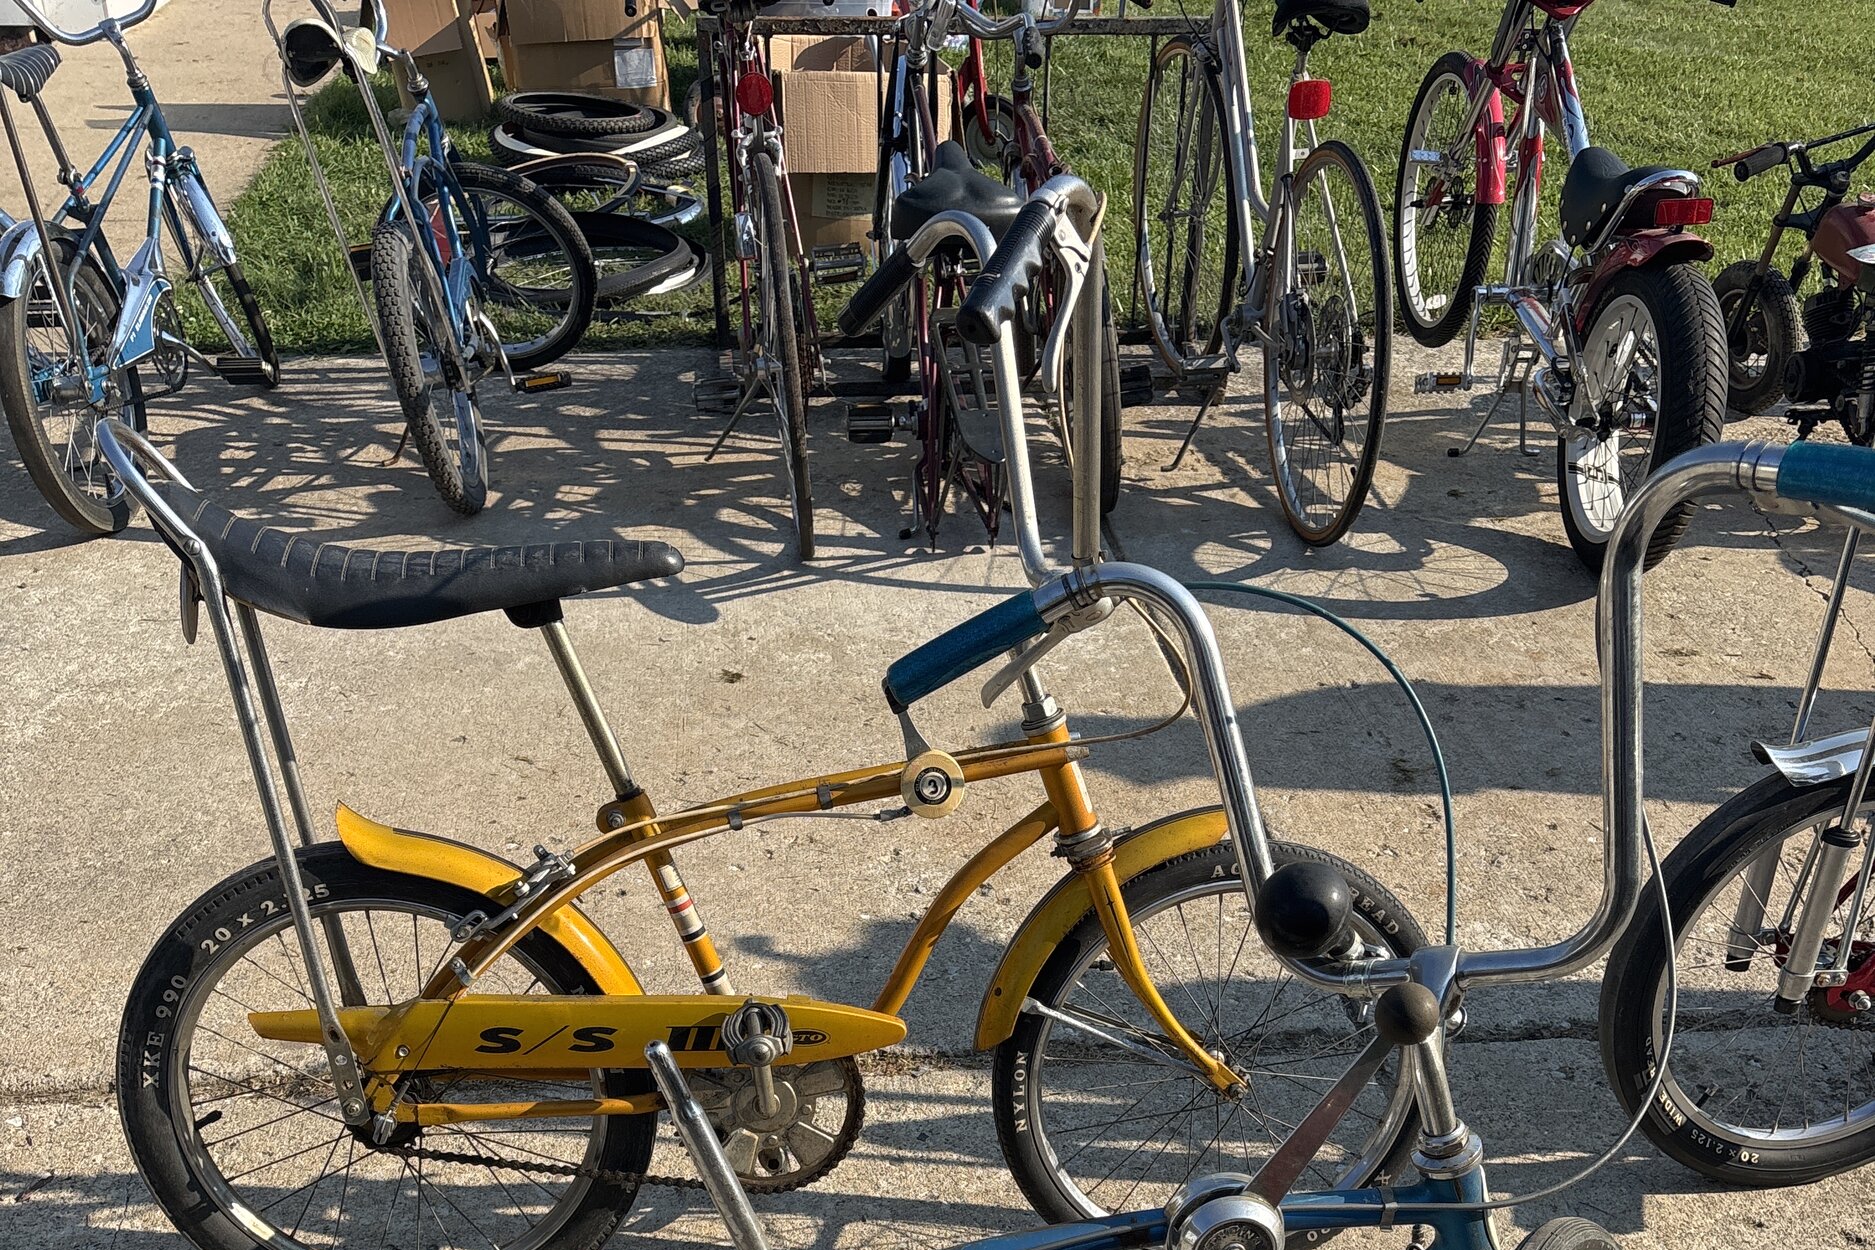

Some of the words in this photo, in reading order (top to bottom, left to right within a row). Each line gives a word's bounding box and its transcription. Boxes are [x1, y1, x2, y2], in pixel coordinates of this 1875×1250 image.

[200, 926, 232, 955] 20
[142, 1030, 166, 1089] XKE
[155, 974, 188, 1020] 990
[475, 1025, 618, 1056] S/S
[1012, 1050, 1029, 1134] NYLON
[1658, 1090, 1684, 1128] WIDE
[1690, 1128, 1723, 1154] 2.125
[1740, 1150, 1760, 1164] 20
